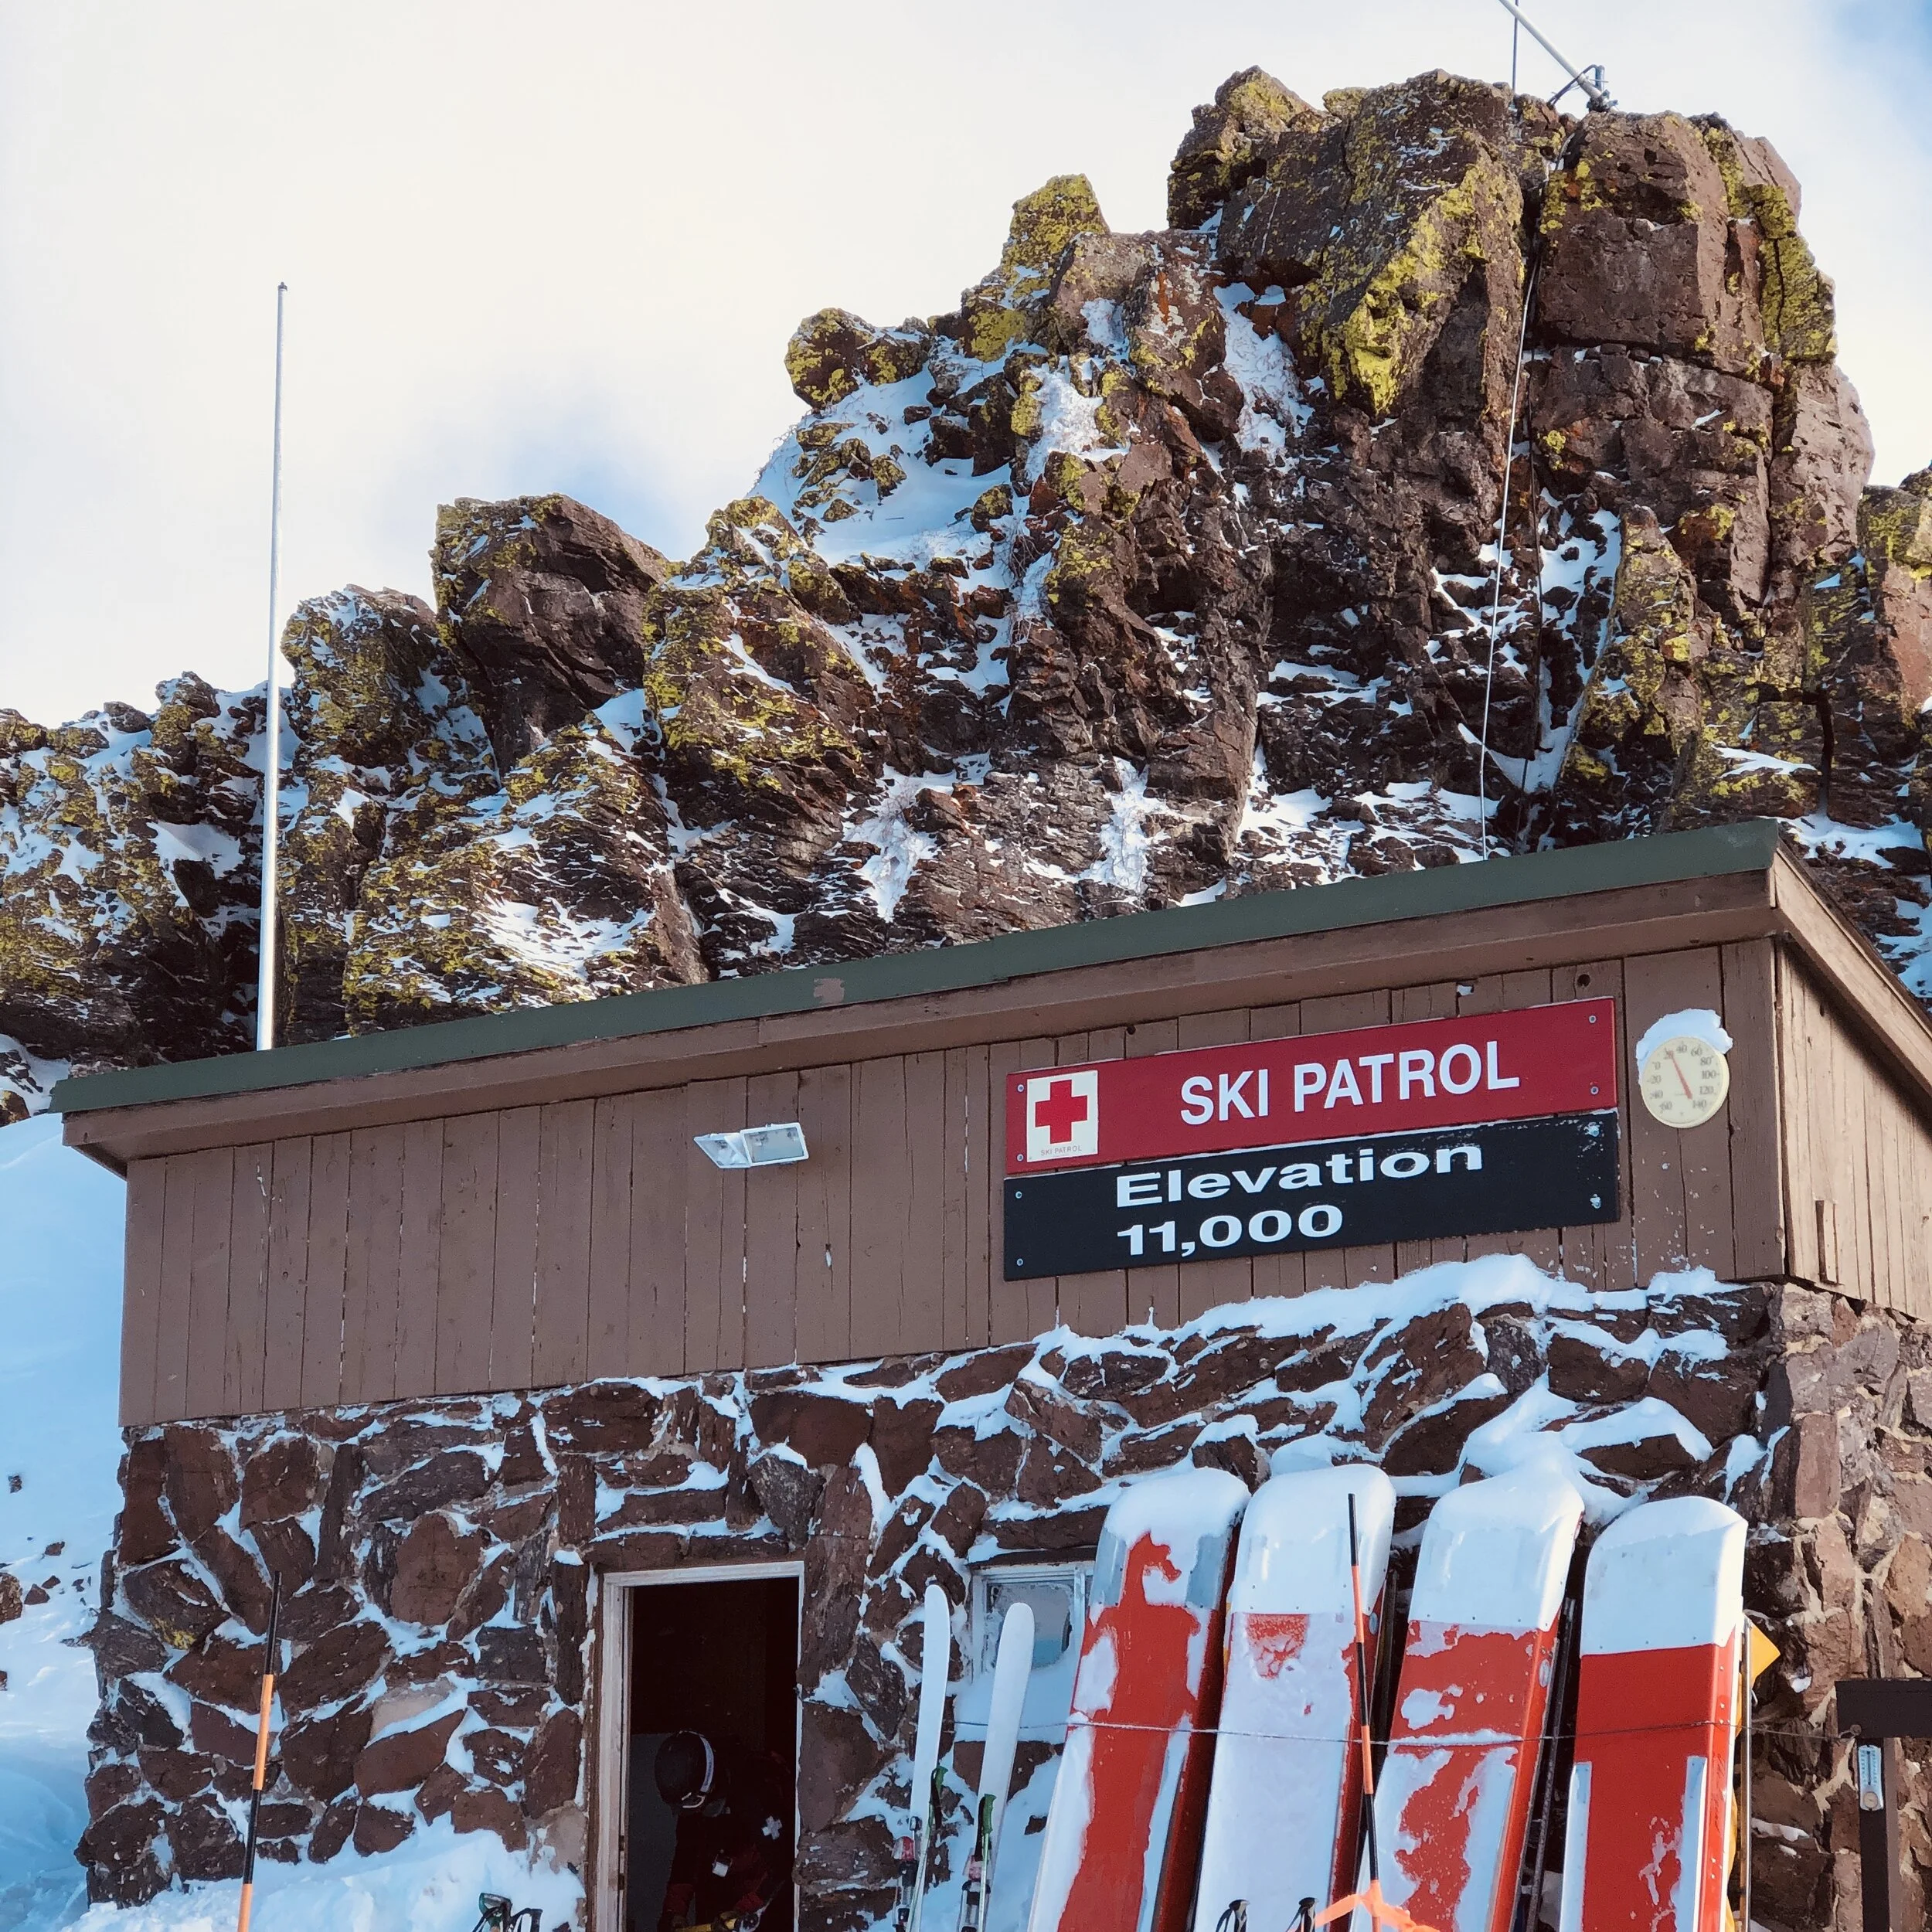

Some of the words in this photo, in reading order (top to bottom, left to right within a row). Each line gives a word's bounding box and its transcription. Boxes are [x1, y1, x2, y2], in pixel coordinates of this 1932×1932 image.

[1675, 1044, 1687, 1053] 40
[1690, 1046, 1702, 1056] 60
[1700, 1056, 1712, 1066] 80
[1702, 1070, 1716, 1079] 100
[1180, 1068, 1269, 1126] SKI
[1294, 1040, 1520, 1113] PATROL
[1699, 1086, 1714, 1094] 120
[1055, 1145, 1082, 1154] PATROL
[1117, 1143, 1482, 1208] Elevation
[1117, 1204, 1342, 1257] 11,000
